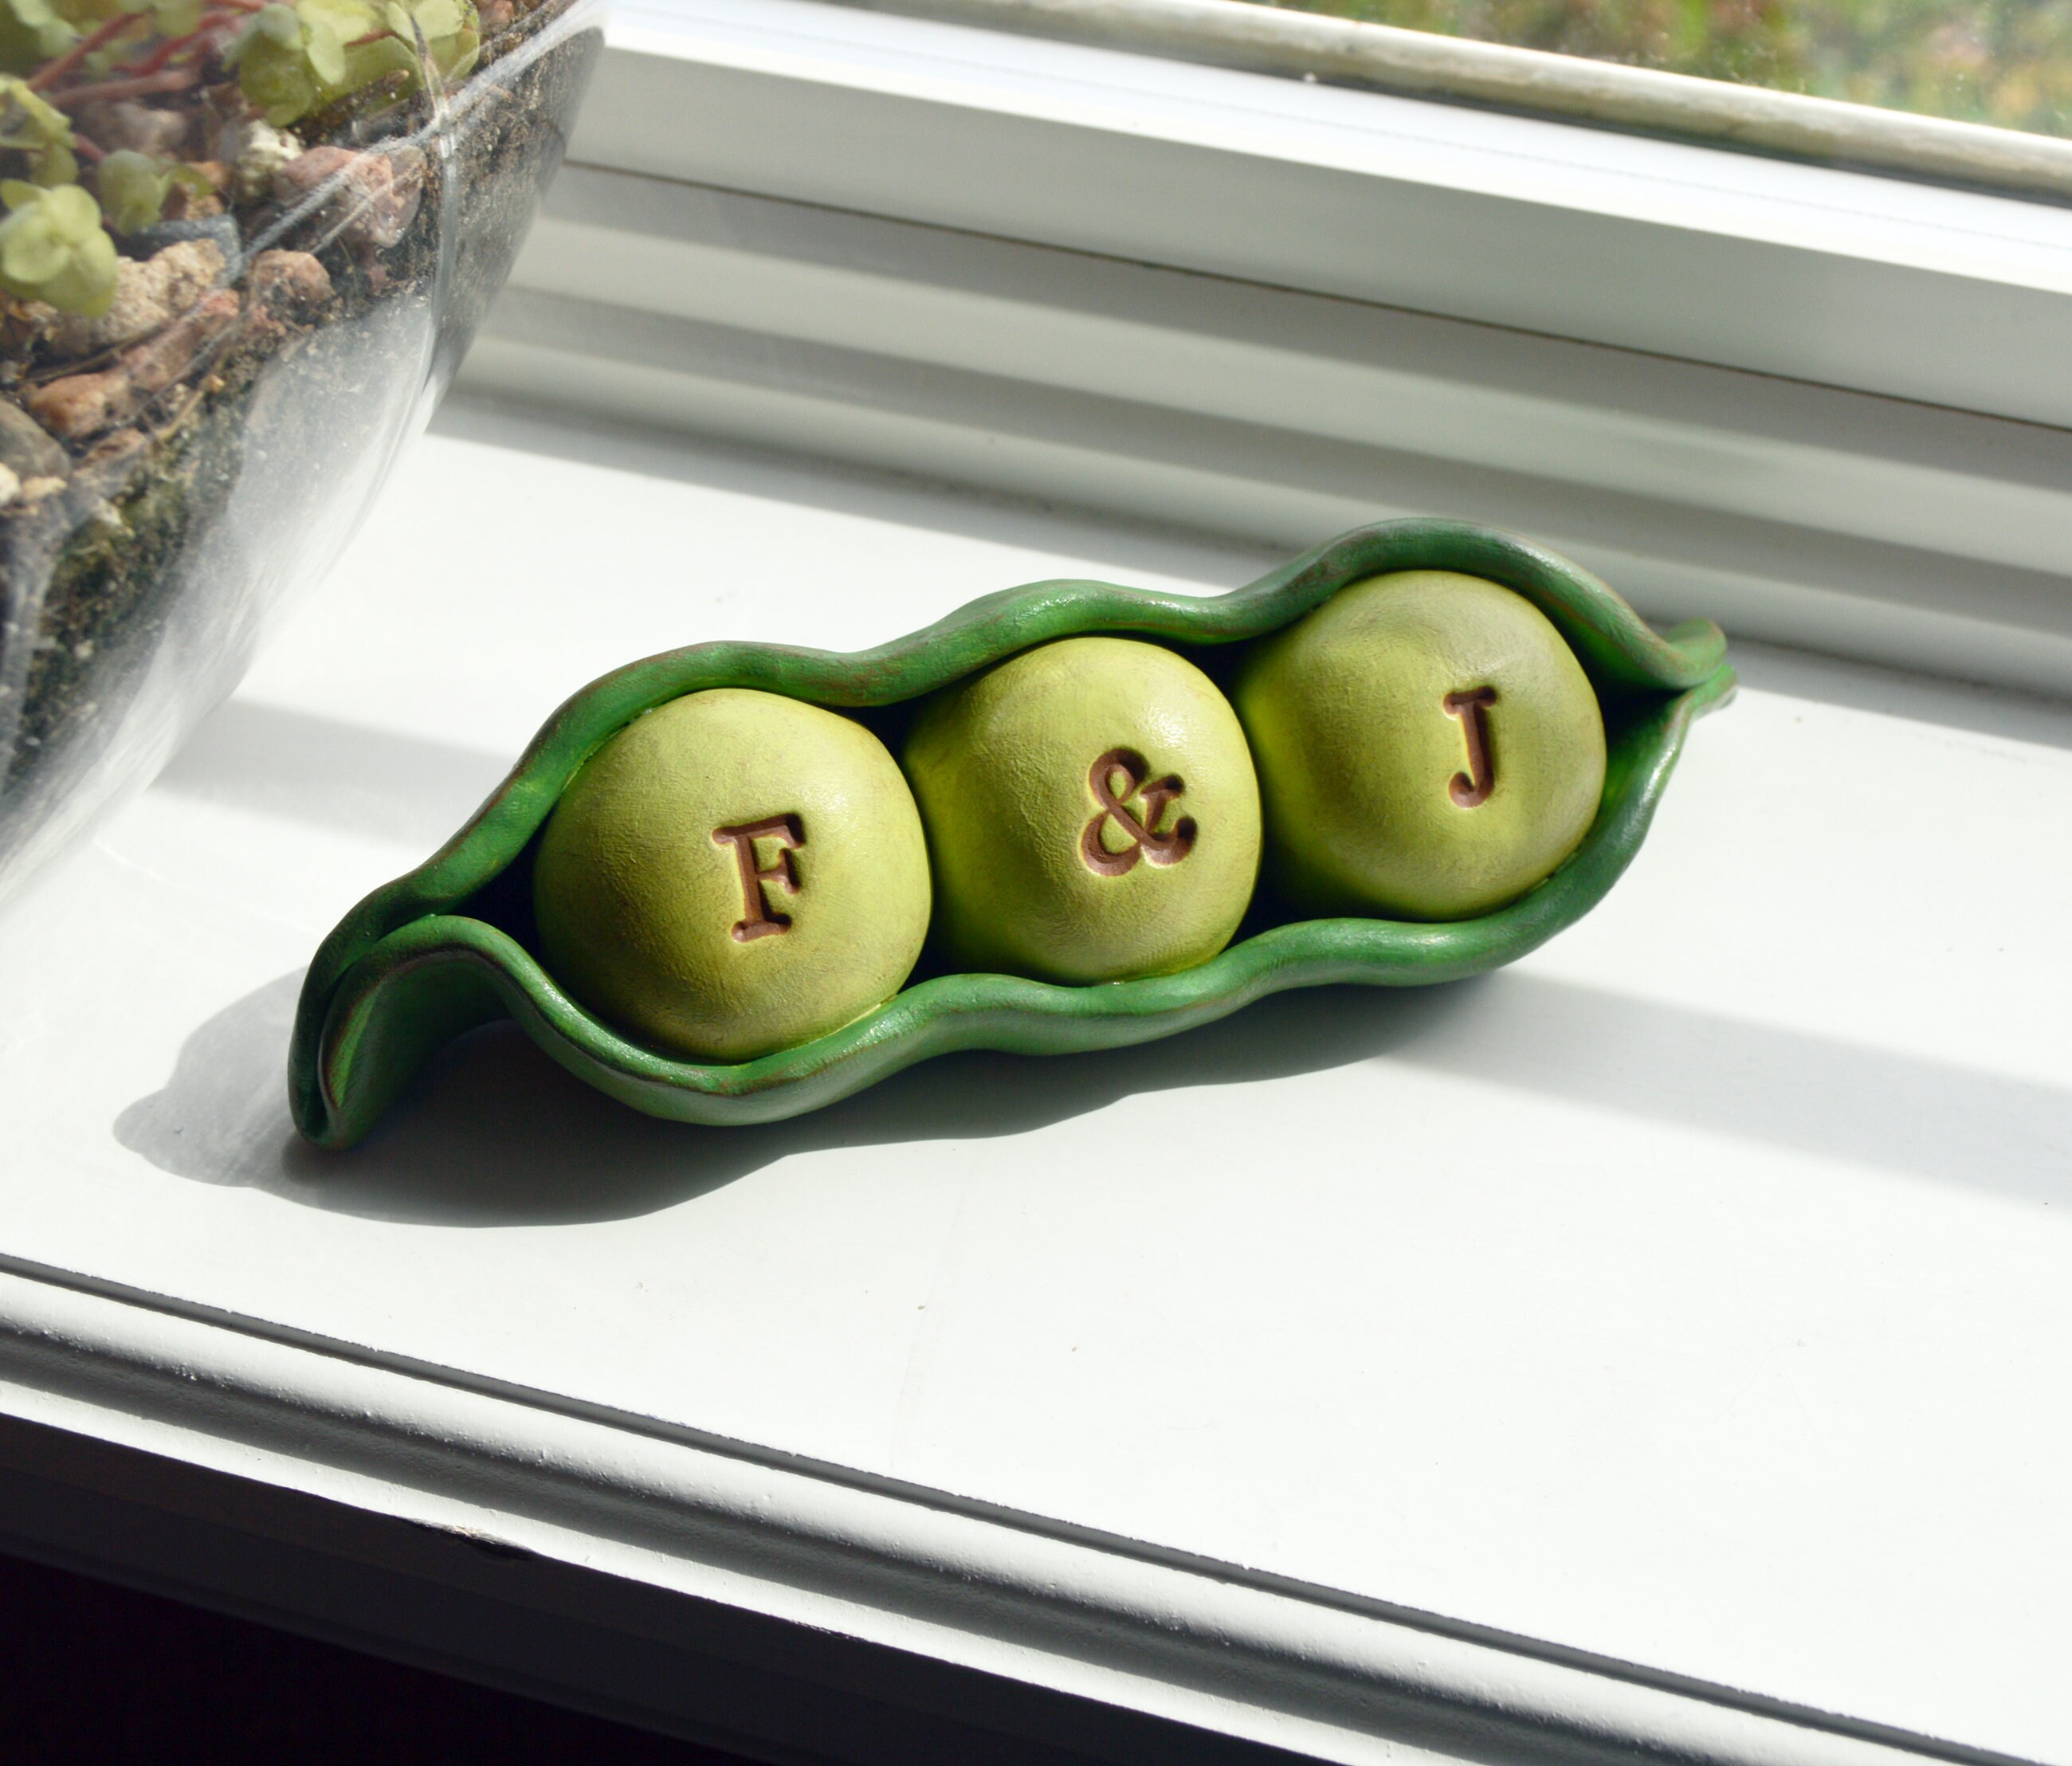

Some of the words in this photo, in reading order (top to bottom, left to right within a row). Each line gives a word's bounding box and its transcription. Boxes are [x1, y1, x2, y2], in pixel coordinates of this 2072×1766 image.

[712, 812, 806, 943] F
[1080, 747, 1197, 877] &
[1442, 685, 1499, 808] J
